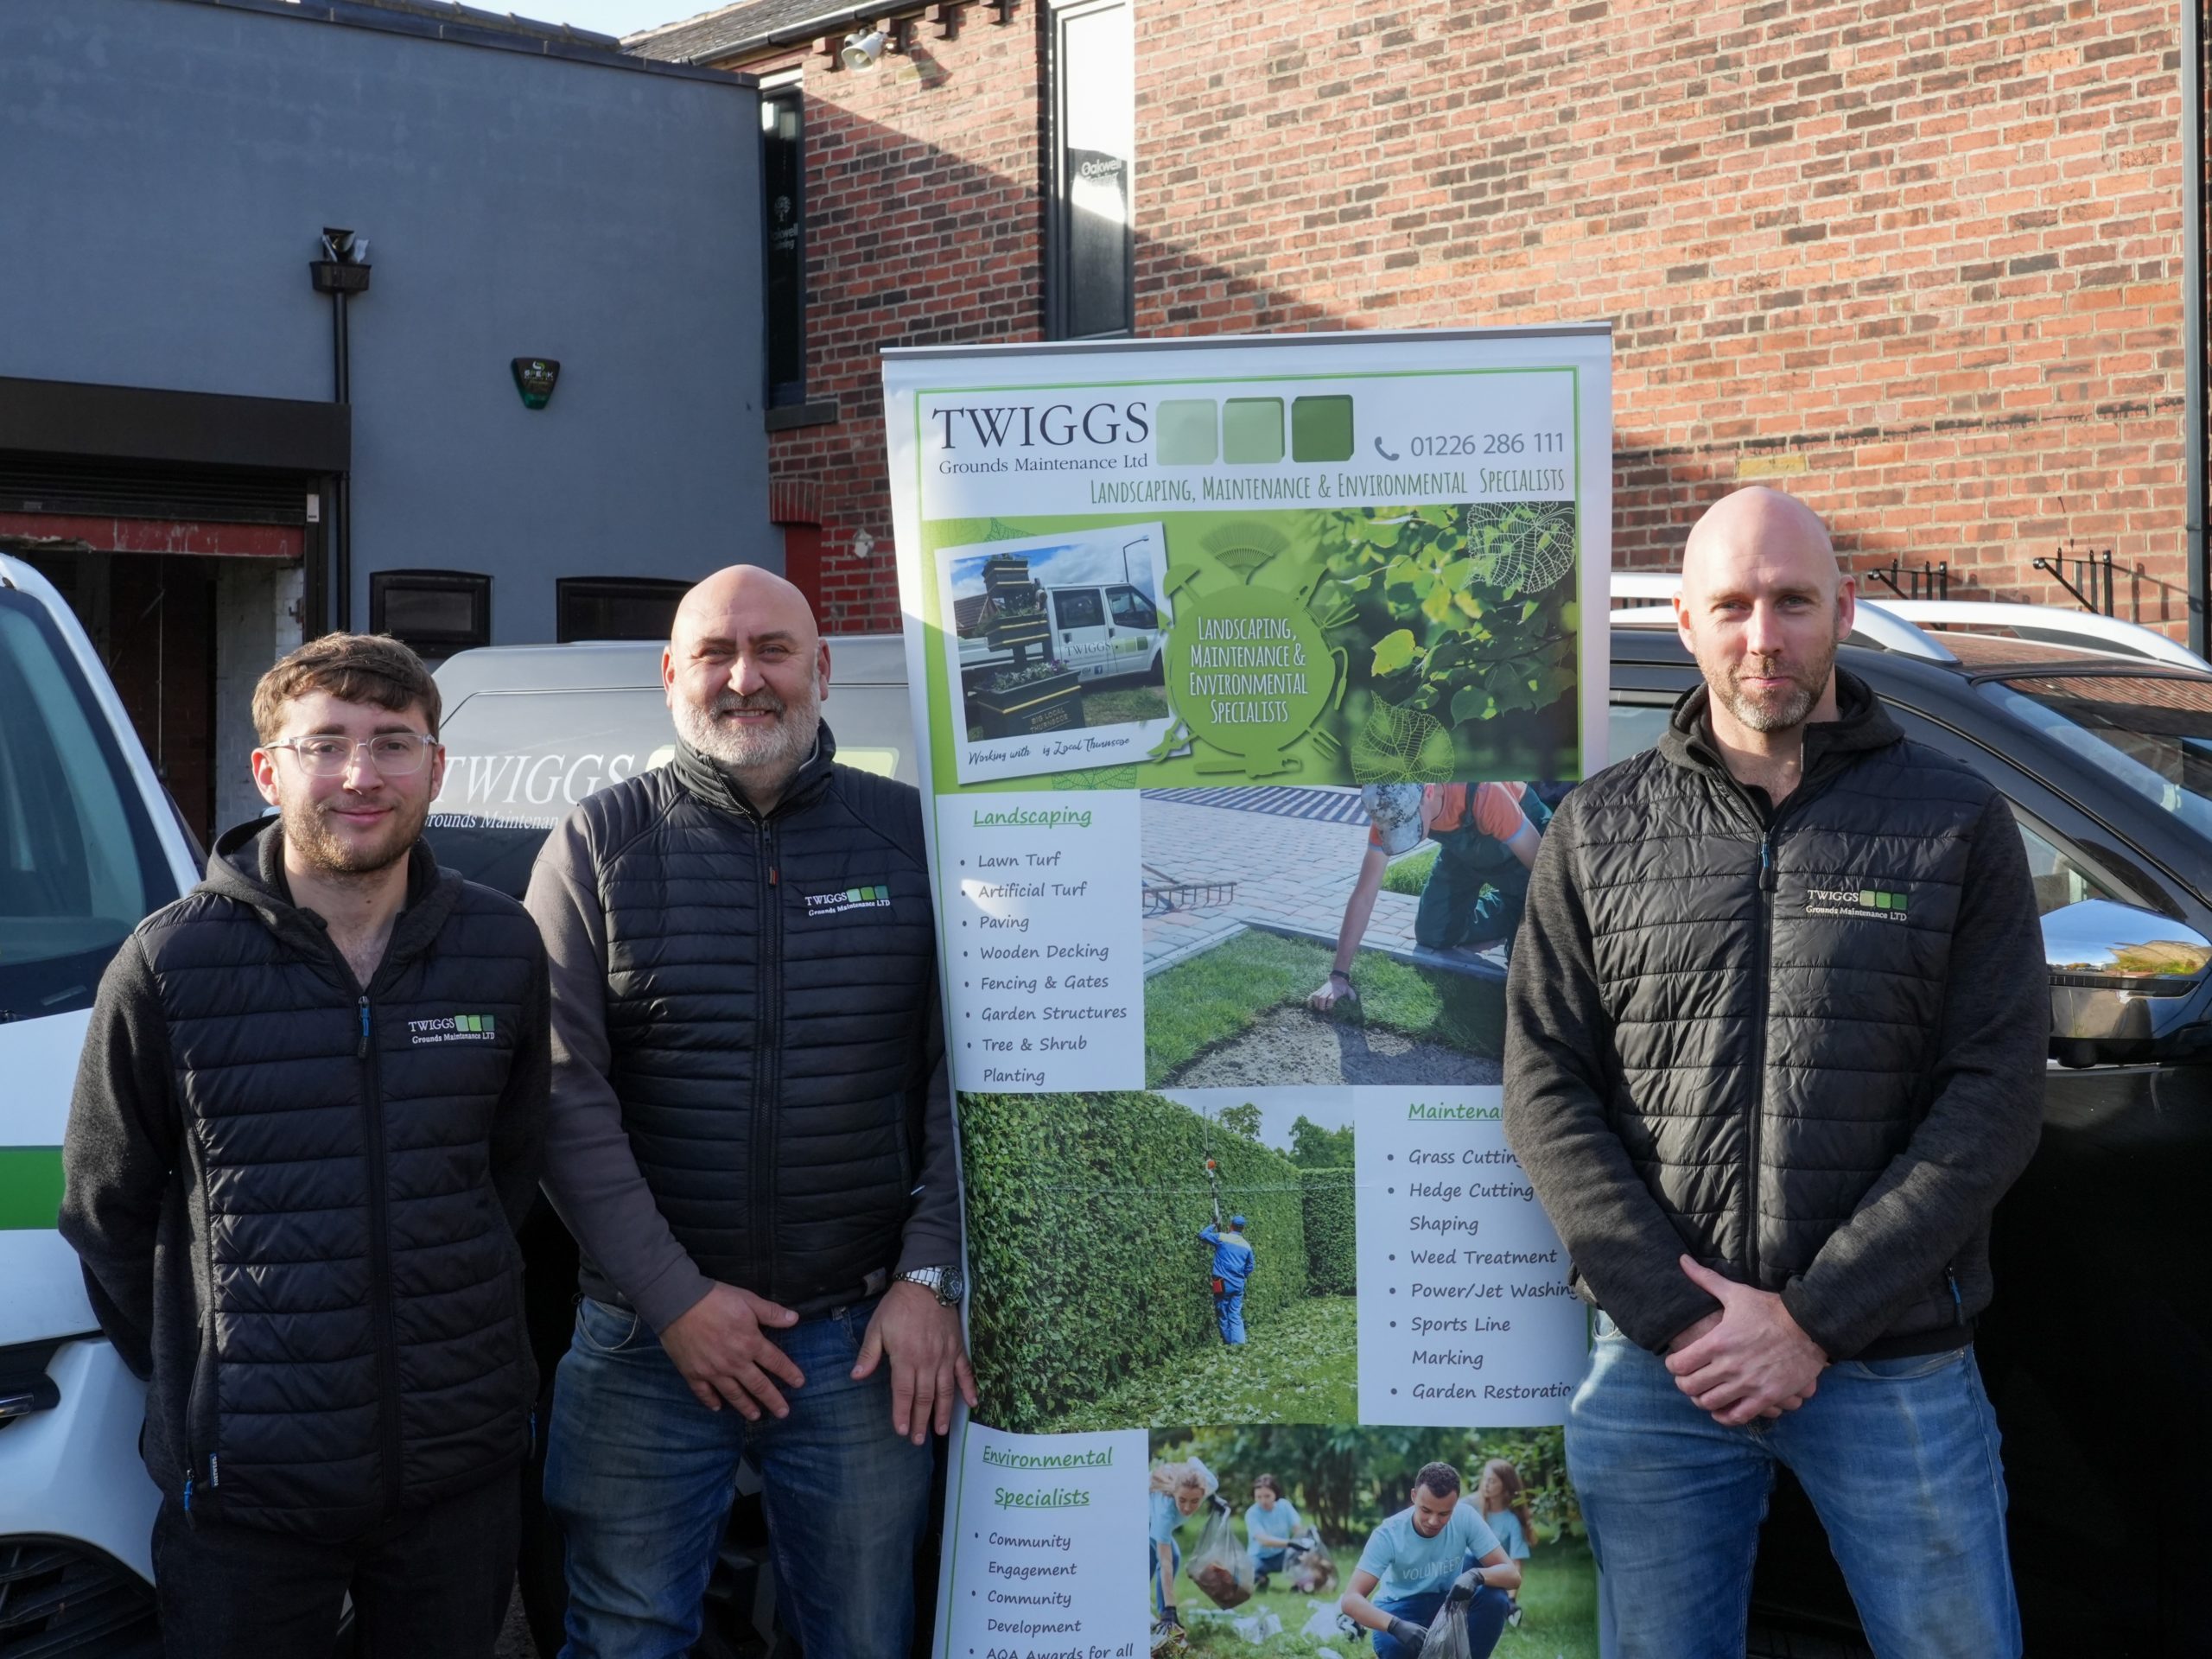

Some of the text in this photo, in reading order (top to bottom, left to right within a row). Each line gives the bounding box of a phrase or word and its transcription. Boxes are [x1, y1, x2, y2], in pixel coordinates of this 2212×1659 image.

[931, 402, 1149, 449] TWIGGS
[1411, 432, 1564, 456] 01226 286 111
[939, 453, 1147, 474] Grounds Maintenance Ltd
[1090, 467, 1565, 504] LANDSCAPING, MAINTENANCE & ENVIRONMENTAL SPECIALISTS
[1198, 616, 1297, 641] LANDSCAPING,
[1065, 640, 1111, 657] TWIGGS
[1191, 642, 1306, 668] MAINTENANCE &
[1190, 672, 1308, 696] ENVIRONMENTAL
[1211, 699, 1288, 724] SPECIALISTS
[969, 750, 1007, 766] Working
[1010, 746, 1030, 760] with
[1084, 737, 1130, 753] Thurnscoe
[432, 753, 635, 805] TWIGGS
[424, 810, 560, 830] rounds Maintenan
[973, 806, 1092, 829] Landscaping
[978, 851, 1061, 868] Lawn Turf
[804, 892, 848, 906] TWIGGS
[978, 881, 1088, 899] Artificial Turf
[1807, 889, 1859, 902] TWIGGS
[808, 907, 836, 917] Grounds
[837, 901, 875, 912] Maintenance
[1806, 906, 1908, 921] Grounds Maintenance LTD
[980, 914, 1030, 932] Paving
[980, 943, 1109, 962] Wooden Decking
[981, 975, 1109, 994] Fencing & Gates
[982, 1006, 1128, 1021] Garden Structures
[408, 1018, 455, 1032] TWIGGS
[412, 1034, 442, 1044] Grounds
[443, 1033, 481, 1041] Maintenance
[982, 1035, 1087, 1052] Tree & Shrub
[983, 1068, 1046, 1086] Planting
[1408, 1102, 1503, 1121] Maintena
[1408, 1148, 1522, 1168] Grass Cuttin
[1409, 1181, 1535, 1202] Hedge Cutting
[1409, 1215, 1479, 1236] Shaping
[1410, 1249, 1557, 1264] Weed Treatment
[1411, 1282, 1503, 1299] Power/Jet
[1411, 1316, 1511, 1336] Sports Line
[1412, 1350, 1484, 1370] Marking
[1413, 1382, 1573, 1399] Garden Restoratio
[982, 1445, 1113, 1469] Environmental
[995, 1487, 1090, 1510] Specialists
[988, 1532, 1071, 1551] Community
[988, 1561, 1077, 1580] Engagement
[988, 1589, 1071, 1608] Community
[988, 1618, 1083, 1638] Development
[1026, 1647, 1084, 1659] Awards
[1089, 1645, 1111, 1659] for
[1116, 1643, 1134, 1657] all
